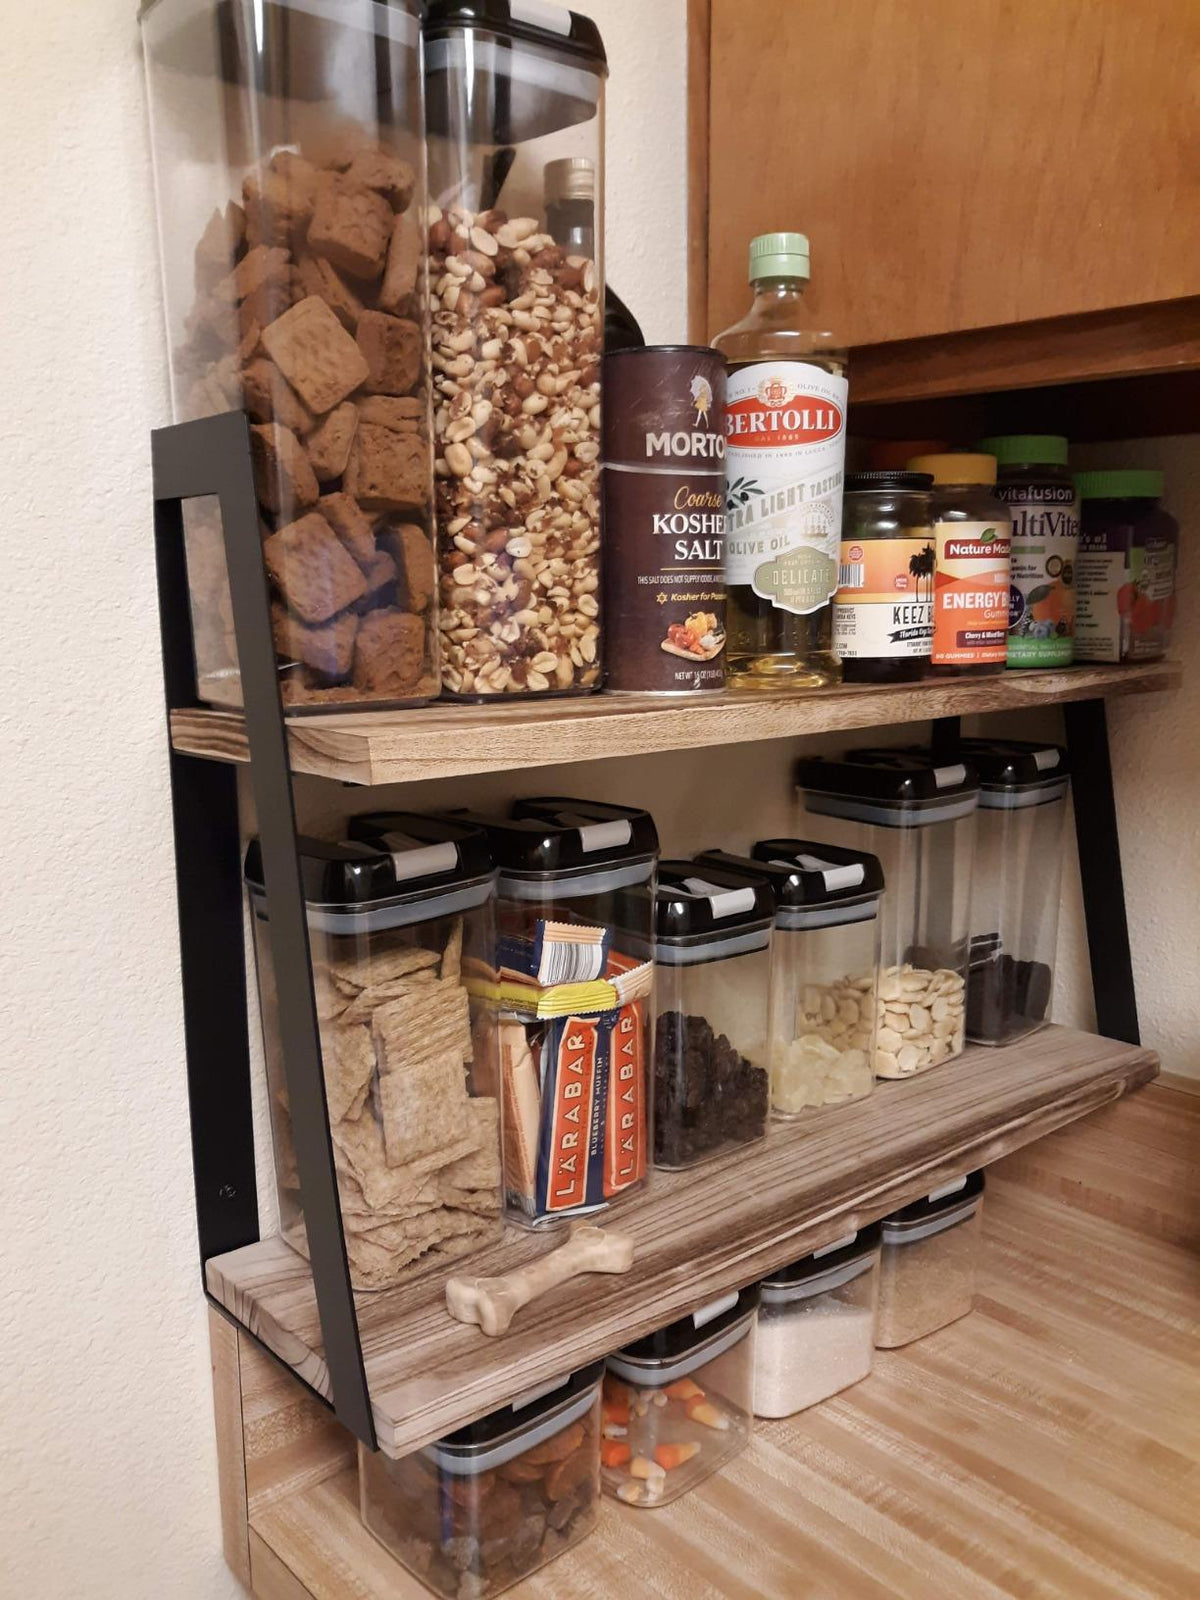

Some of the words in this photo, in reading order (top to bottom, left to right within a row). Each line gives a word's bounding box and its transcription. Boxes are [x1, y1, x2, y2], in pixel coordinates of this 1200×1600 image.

[726, 408, 835, 436] BERTOLLI
[645, 431, 727, 459] MORTO
[674, 485, 723, 510] Coarse
[999, 485, 1073, 501] vitafusion
[726, 504, 755, 533] TRA
[760, 483, 806, 518] LIGHT
[652, 513, 728, 534] KOSHE
[1012, 510, 1078, 538] ultiVite
[674, 539, 723, 560] SALT
[728, 540, 765, 556] OLIVE
[770, 535, 791, 550] OIL
[949, 544, 991, 555] Nature
[772, 568, 831, 587] DELICATE
[670, 592, 700, 601] Kosher
[700, 592, 711, 600] for
[943, 591, 1001, 609] ENERGY
[893, 605, 924, 625] KEEZ
[620, 1017, 634, 1175] LÄRABAR
[556, 1033, 585, 1196] LÄRABAR
[590, 1098, 600, 1156] BLUEBERRY
